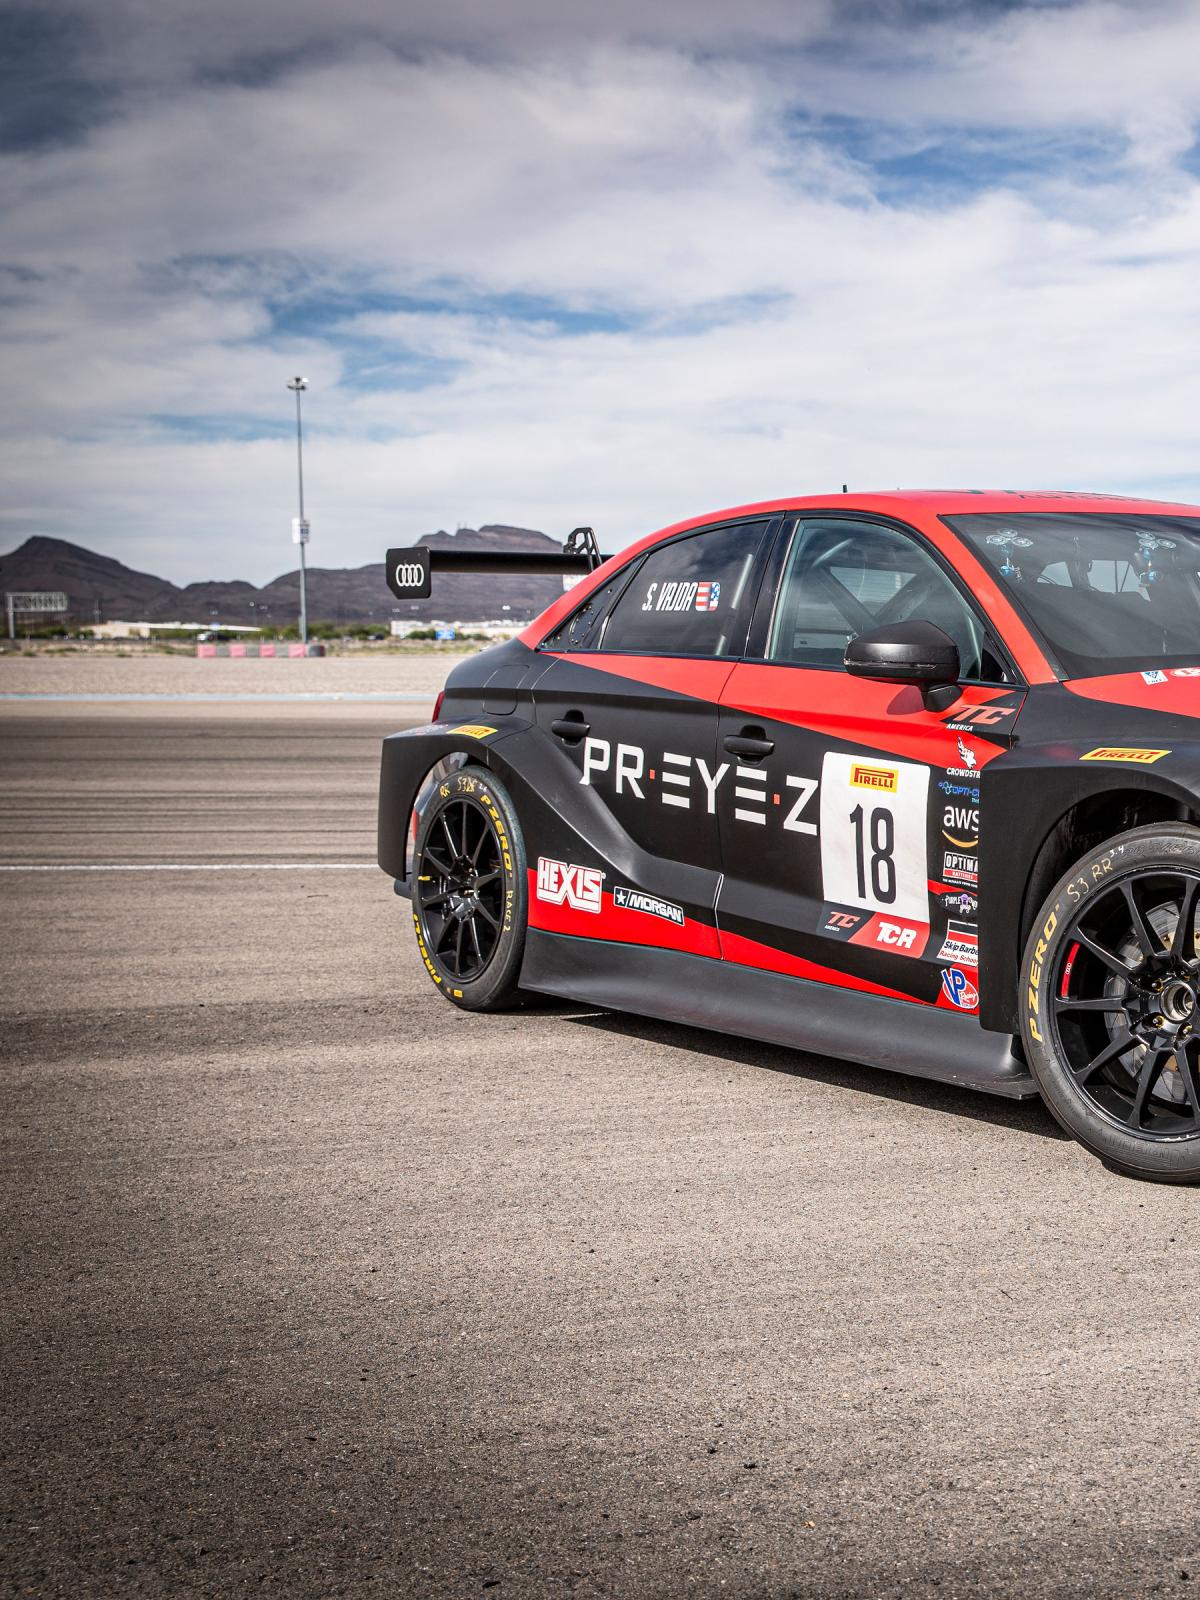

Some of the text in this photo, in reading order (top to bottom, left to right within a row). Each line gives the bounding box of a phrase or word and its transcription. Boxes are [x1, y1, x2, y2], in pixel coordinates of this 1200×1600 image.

[952, 704, 1016, 725] TC
[1090, 749, 1160, 760] PIRELLI
[854, 767, 895, 789] PIRELLI
[943, 805, 980, 832] aws
[849, 803, 897, 905] 18
[538, 858, 602, 908] HEXIS
[629, 893, 683, 924] MORGAN
[827, 911, 862, 929] TC
[876, 921, 918, 950] TCR
